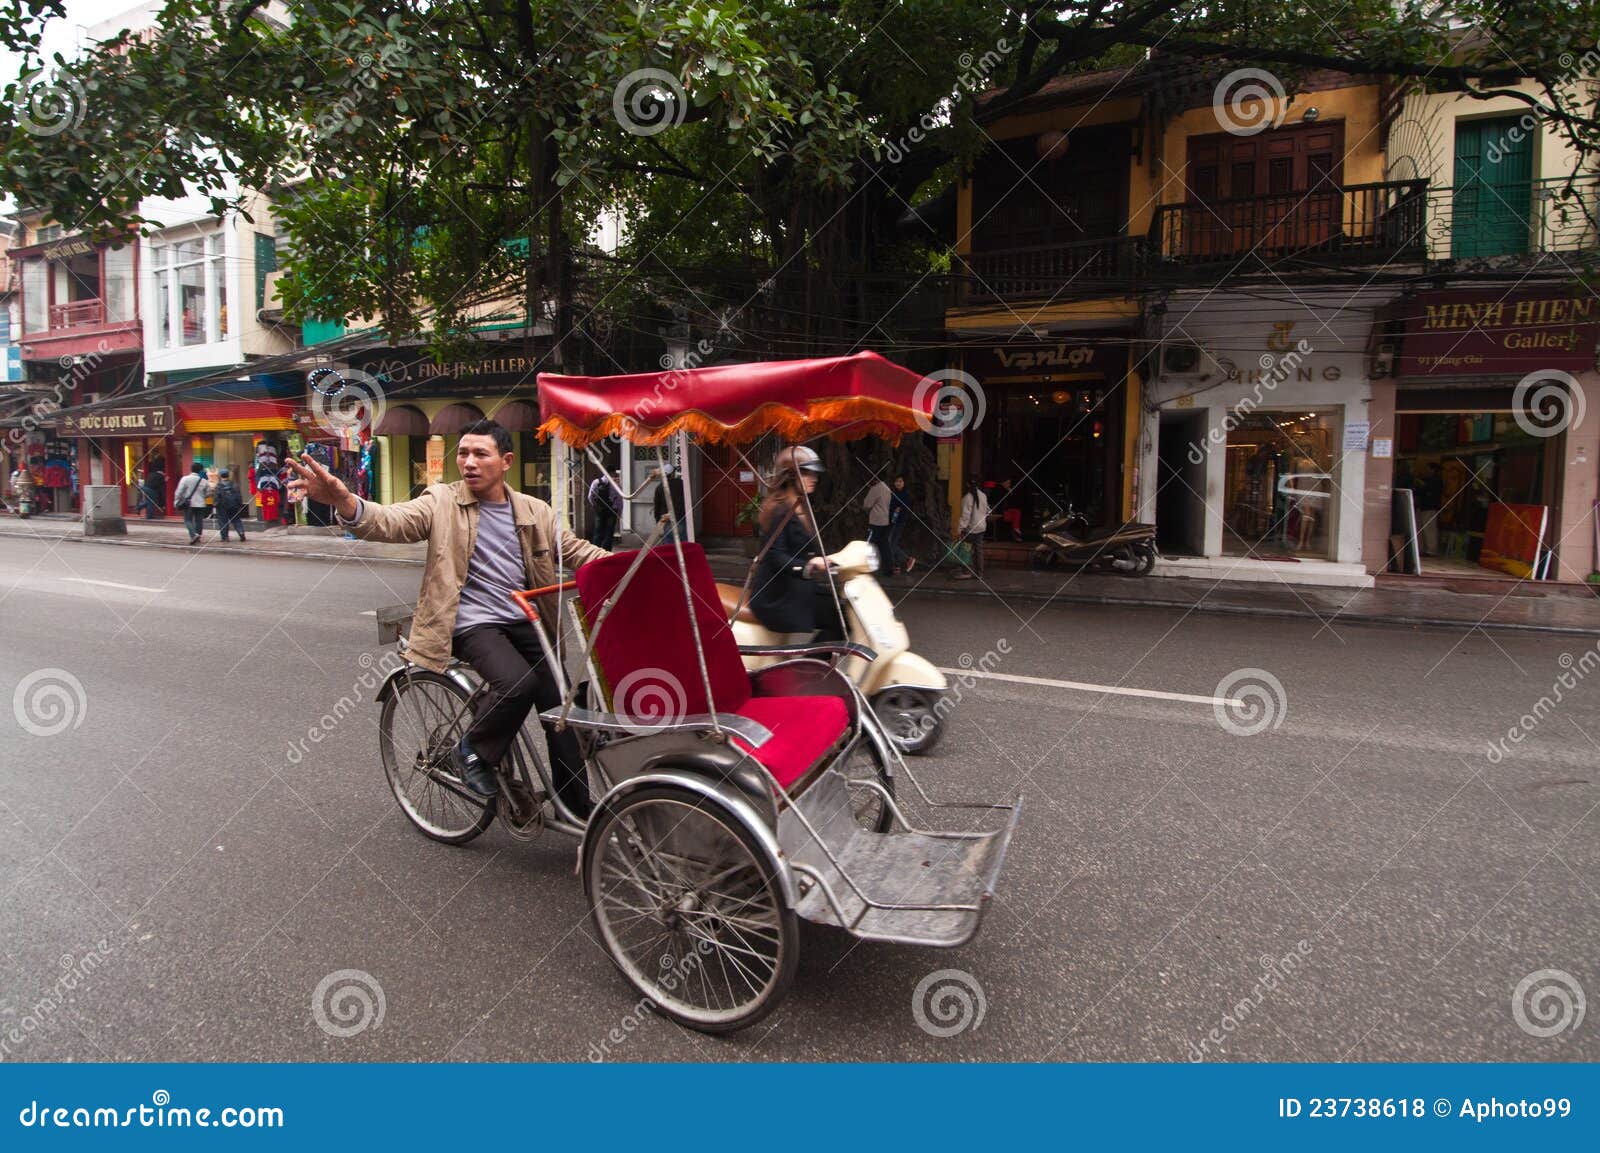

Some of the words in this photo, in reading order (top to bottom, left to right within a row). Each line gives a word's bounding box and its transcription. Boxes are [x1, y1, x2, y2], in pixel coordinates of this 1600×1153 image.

[1423, 303, 1504, 329] MINH
[1512, 298, 1593, 325] HIEN
[1503, 331, 1581, 351] Gallery
[418, 362, 450, 378] FINE
[451, 357, 537, 379] JEWELLERY
[122, 415, 147, 428] SILK
[152, 411, 164, 426] 77
